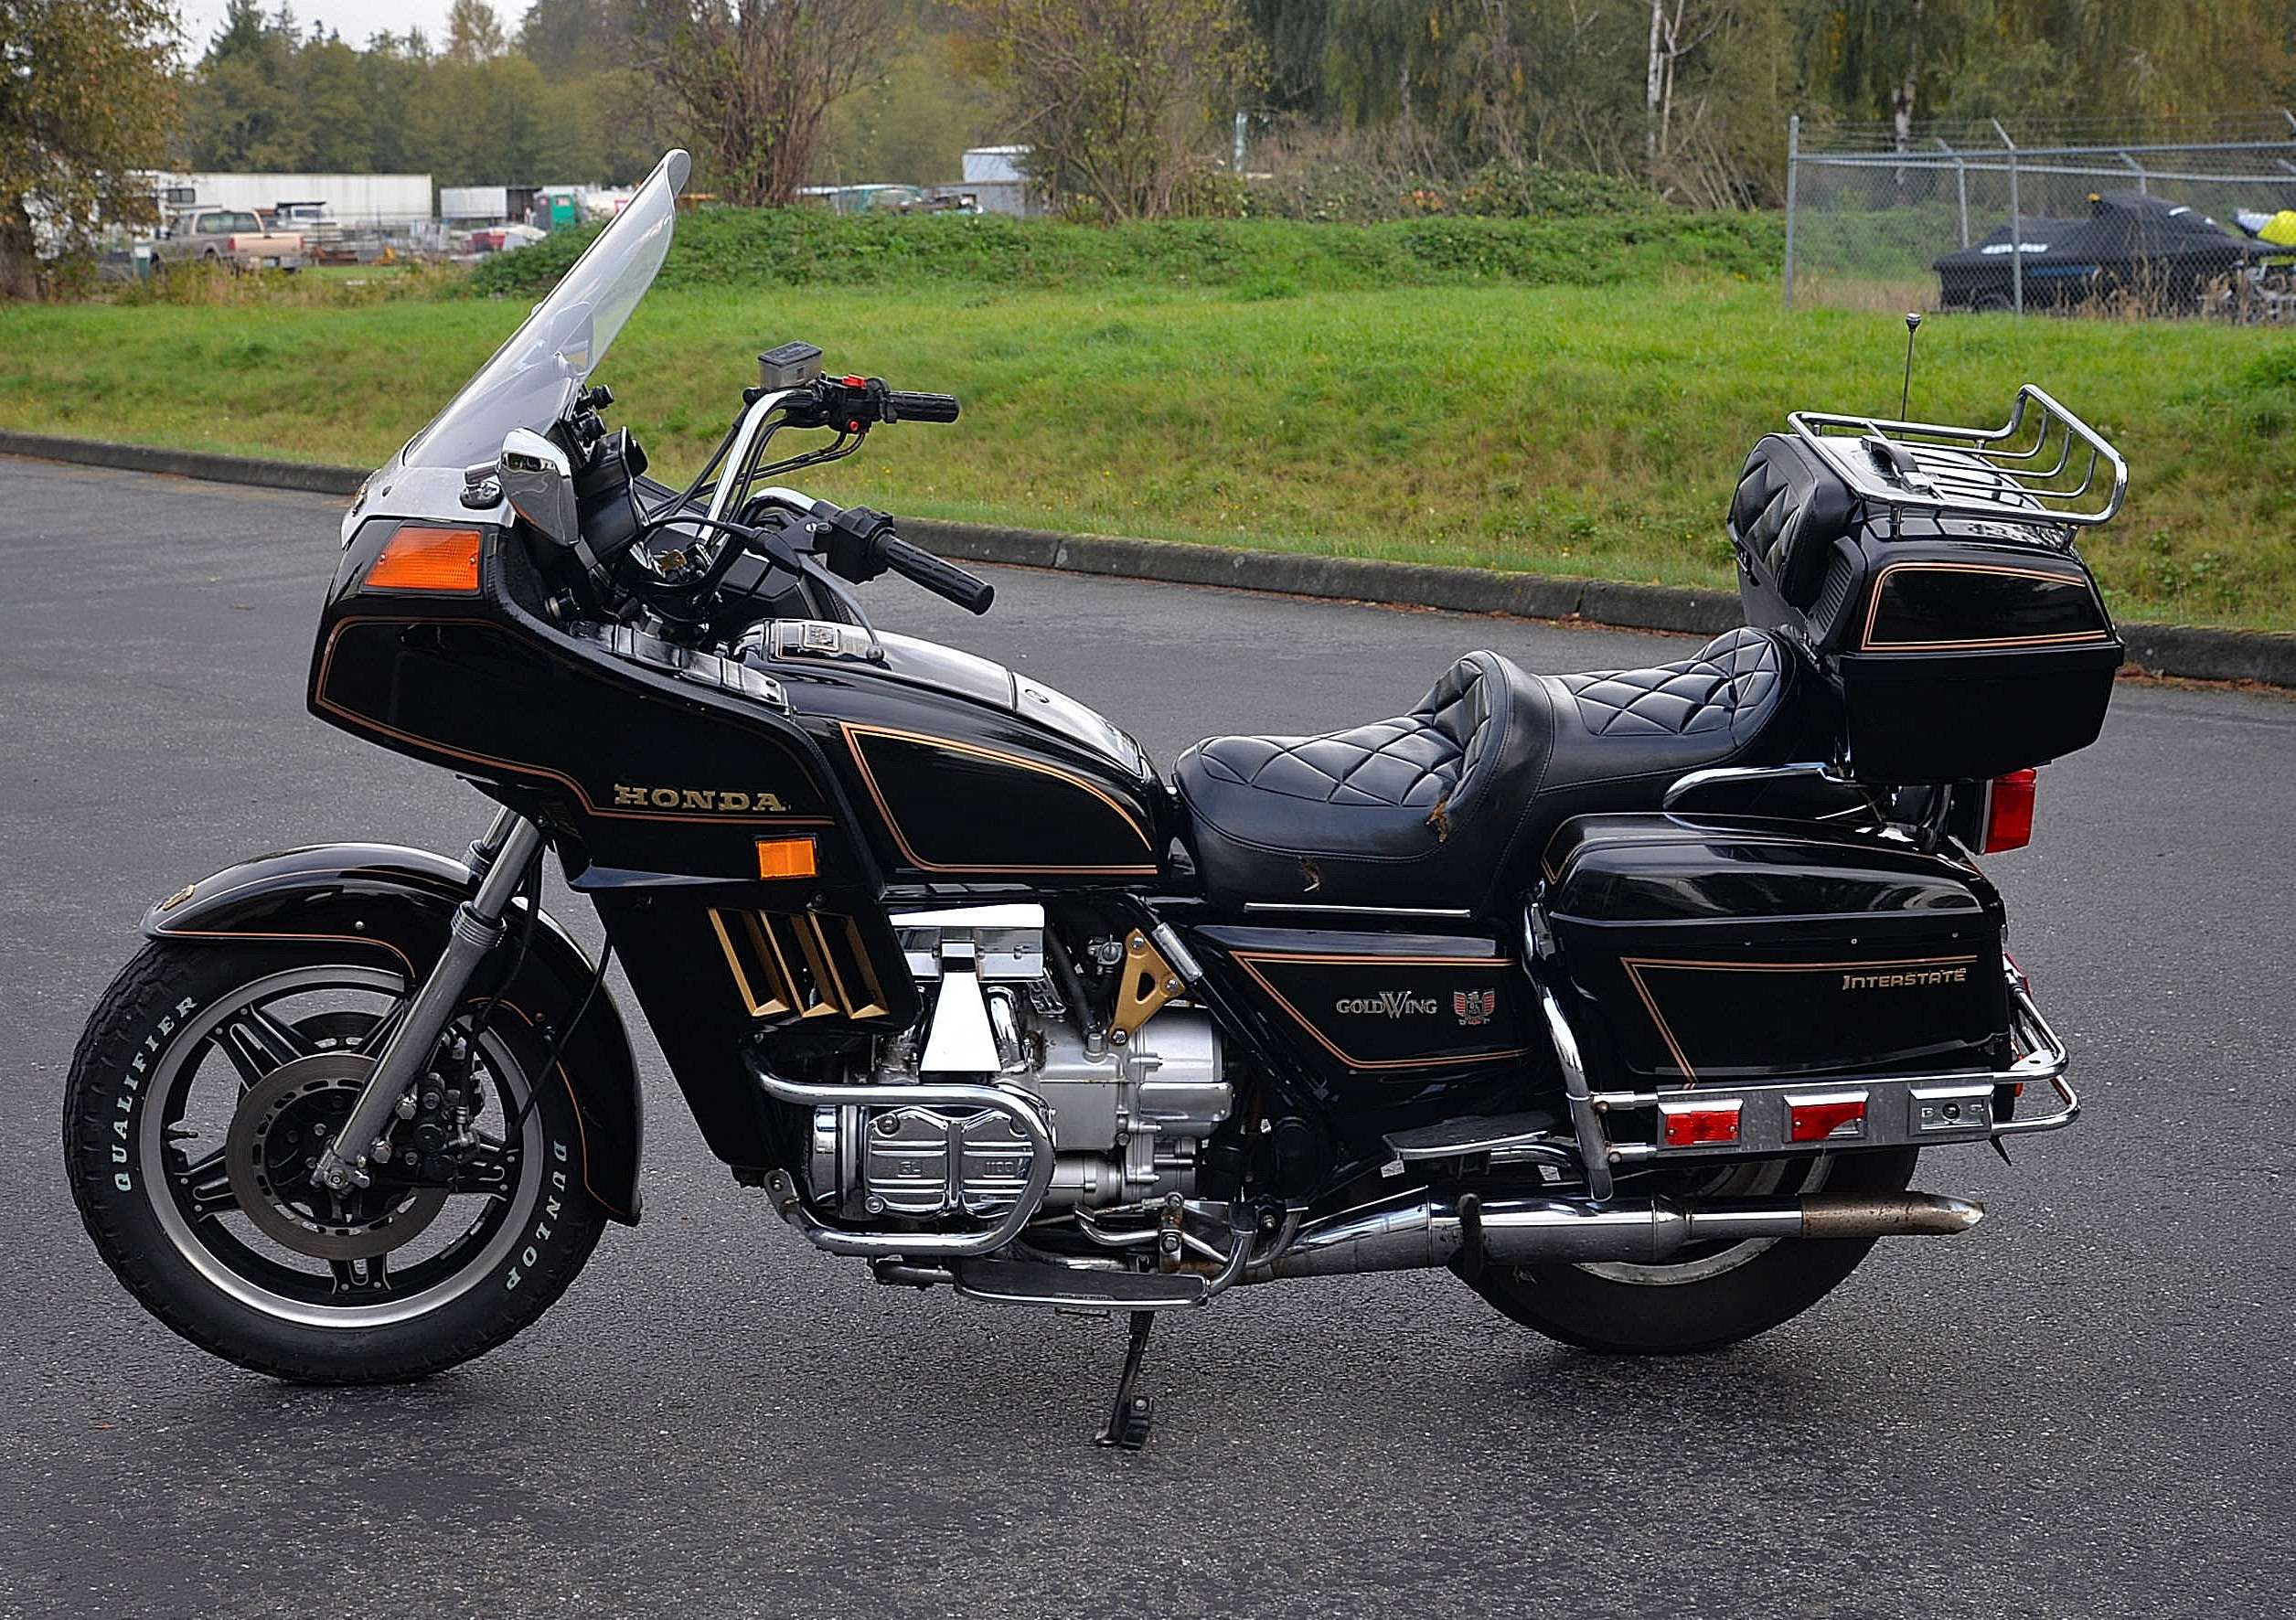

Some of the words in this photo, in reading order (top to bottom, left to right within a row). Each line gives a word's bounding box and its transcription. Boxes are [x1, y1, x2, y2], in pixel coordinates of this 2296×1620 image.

[614, 783, 786, 812] HONDA
[1842, 967, 1967, 990] INTERSTATE
[112, 997, 198, 1192] QUALIFIER
[507, 1141, 567, 1290] DUNLOP
